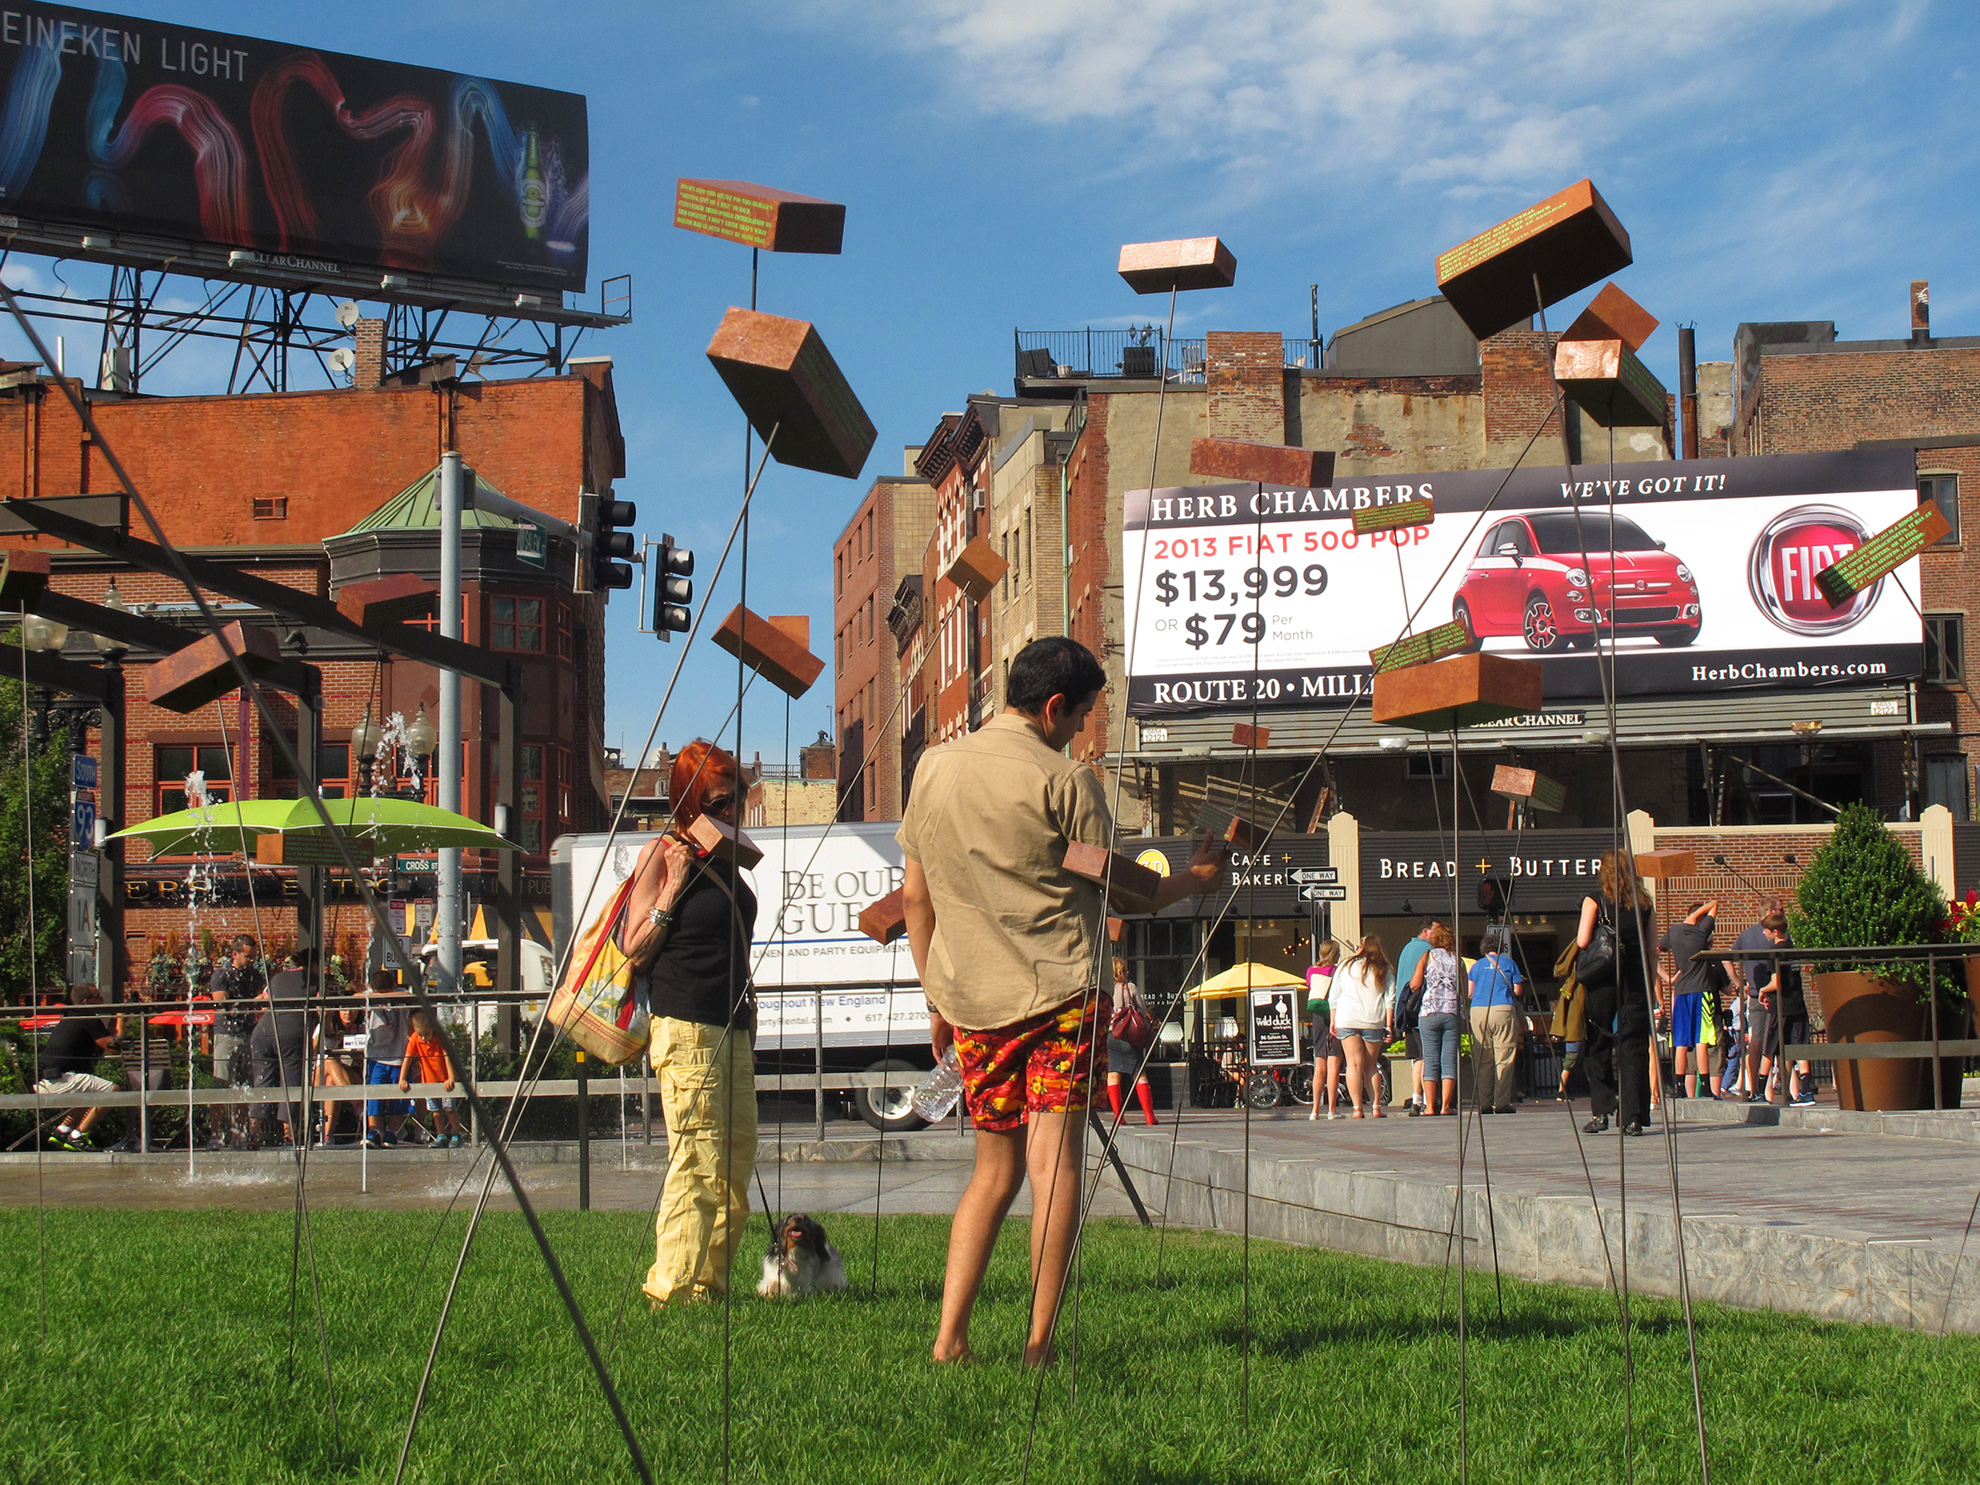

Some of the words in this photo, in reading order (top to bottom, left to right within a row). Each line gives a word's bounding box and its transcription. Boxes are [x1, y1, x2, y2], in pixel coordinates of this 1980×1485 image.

[161, 38, 249, 81] LIGHT
[1637, 476, 1687, 495] GOT
[1693, 474, 1726, 492] IT!
[1151, 494, 1238, 521] HERB
[1249, 483, 1434, 515] CHAMBERS
[1154, 538, 1217, 559] 2013
[1229, 532, 1293, 556] FIAT
[1304, 528, 1359, 552] 500
[1371, 525, 1430, 549] POP
[1155, 564, 1329, 607] $13,999
[1155, 618, 1178, 632] OR
[1185, 611, 1267, 650] $79
[1272, 614, 1293, 625] Per
[1272, 629, 1313, 642] Month
[1691, 661, 1888, 681] HerbChambers.com
[1153, 678, 1247, 704] ROUTE
[1252, 677, 1281, 700] 20
[1301, 672, 1374, 698] MILL
[76, 760, 96, 782] SOUTH
[77, 804, 94, 840] 93
[405, 860, 429, 870] CROSS
[1379, 857, 1457, 879] BREAD
[1509, 856, 1603, 877] BUTTER
[781, 870, 826, 900] BE
[835, 865, 905, 898] OUR
[1231, 872, 1288, 886] BAKER
[78, 899, 91, 932] 1A
[775, 901, 865, 935] GUE
[753, 949, 783, 959] LINEN
[787, 948, 810, 957] AND
[813, 946, 848, 956] PARTY
[849, 944, 910, 954] EQUIPMENT
[839, 995, 886, 1009] England
